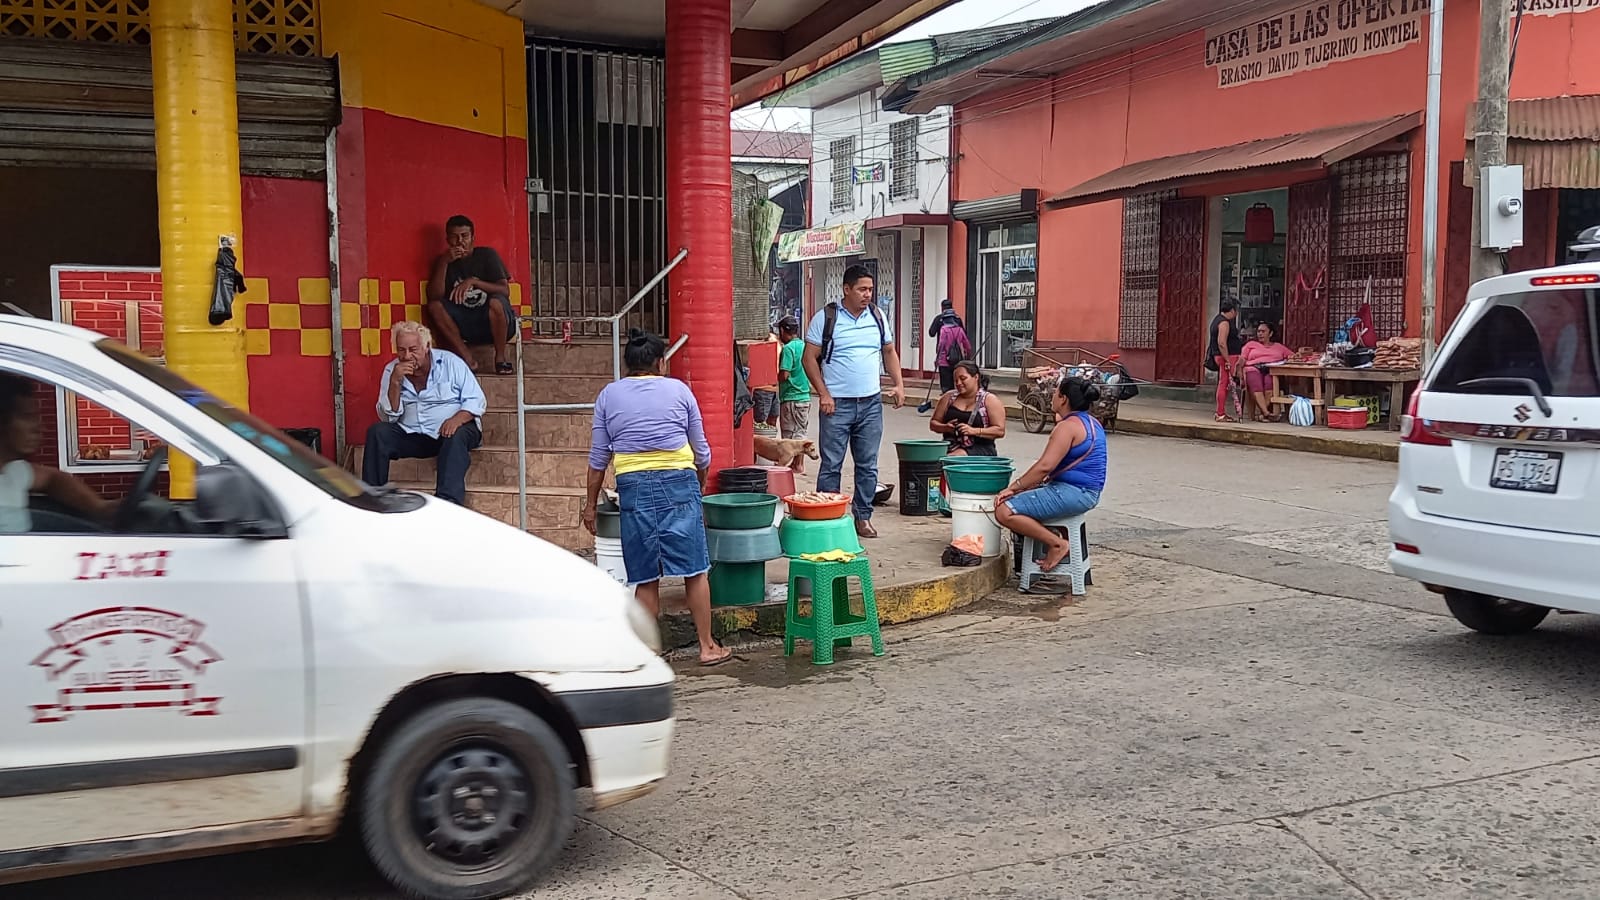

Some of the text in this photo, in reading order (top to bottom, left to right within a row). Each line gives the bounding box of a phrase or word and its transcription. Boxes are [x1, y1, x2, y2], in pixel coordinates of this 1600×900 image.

[1205, 0, 1430, 66] CASA DE LAS OFER
[1220, 20, 1419, 86] ERASMO DAVID TIJERINO MONTIEL
[1519, 462, 1554, 482] 1396
[74, 550, 171, 580] TAXI
